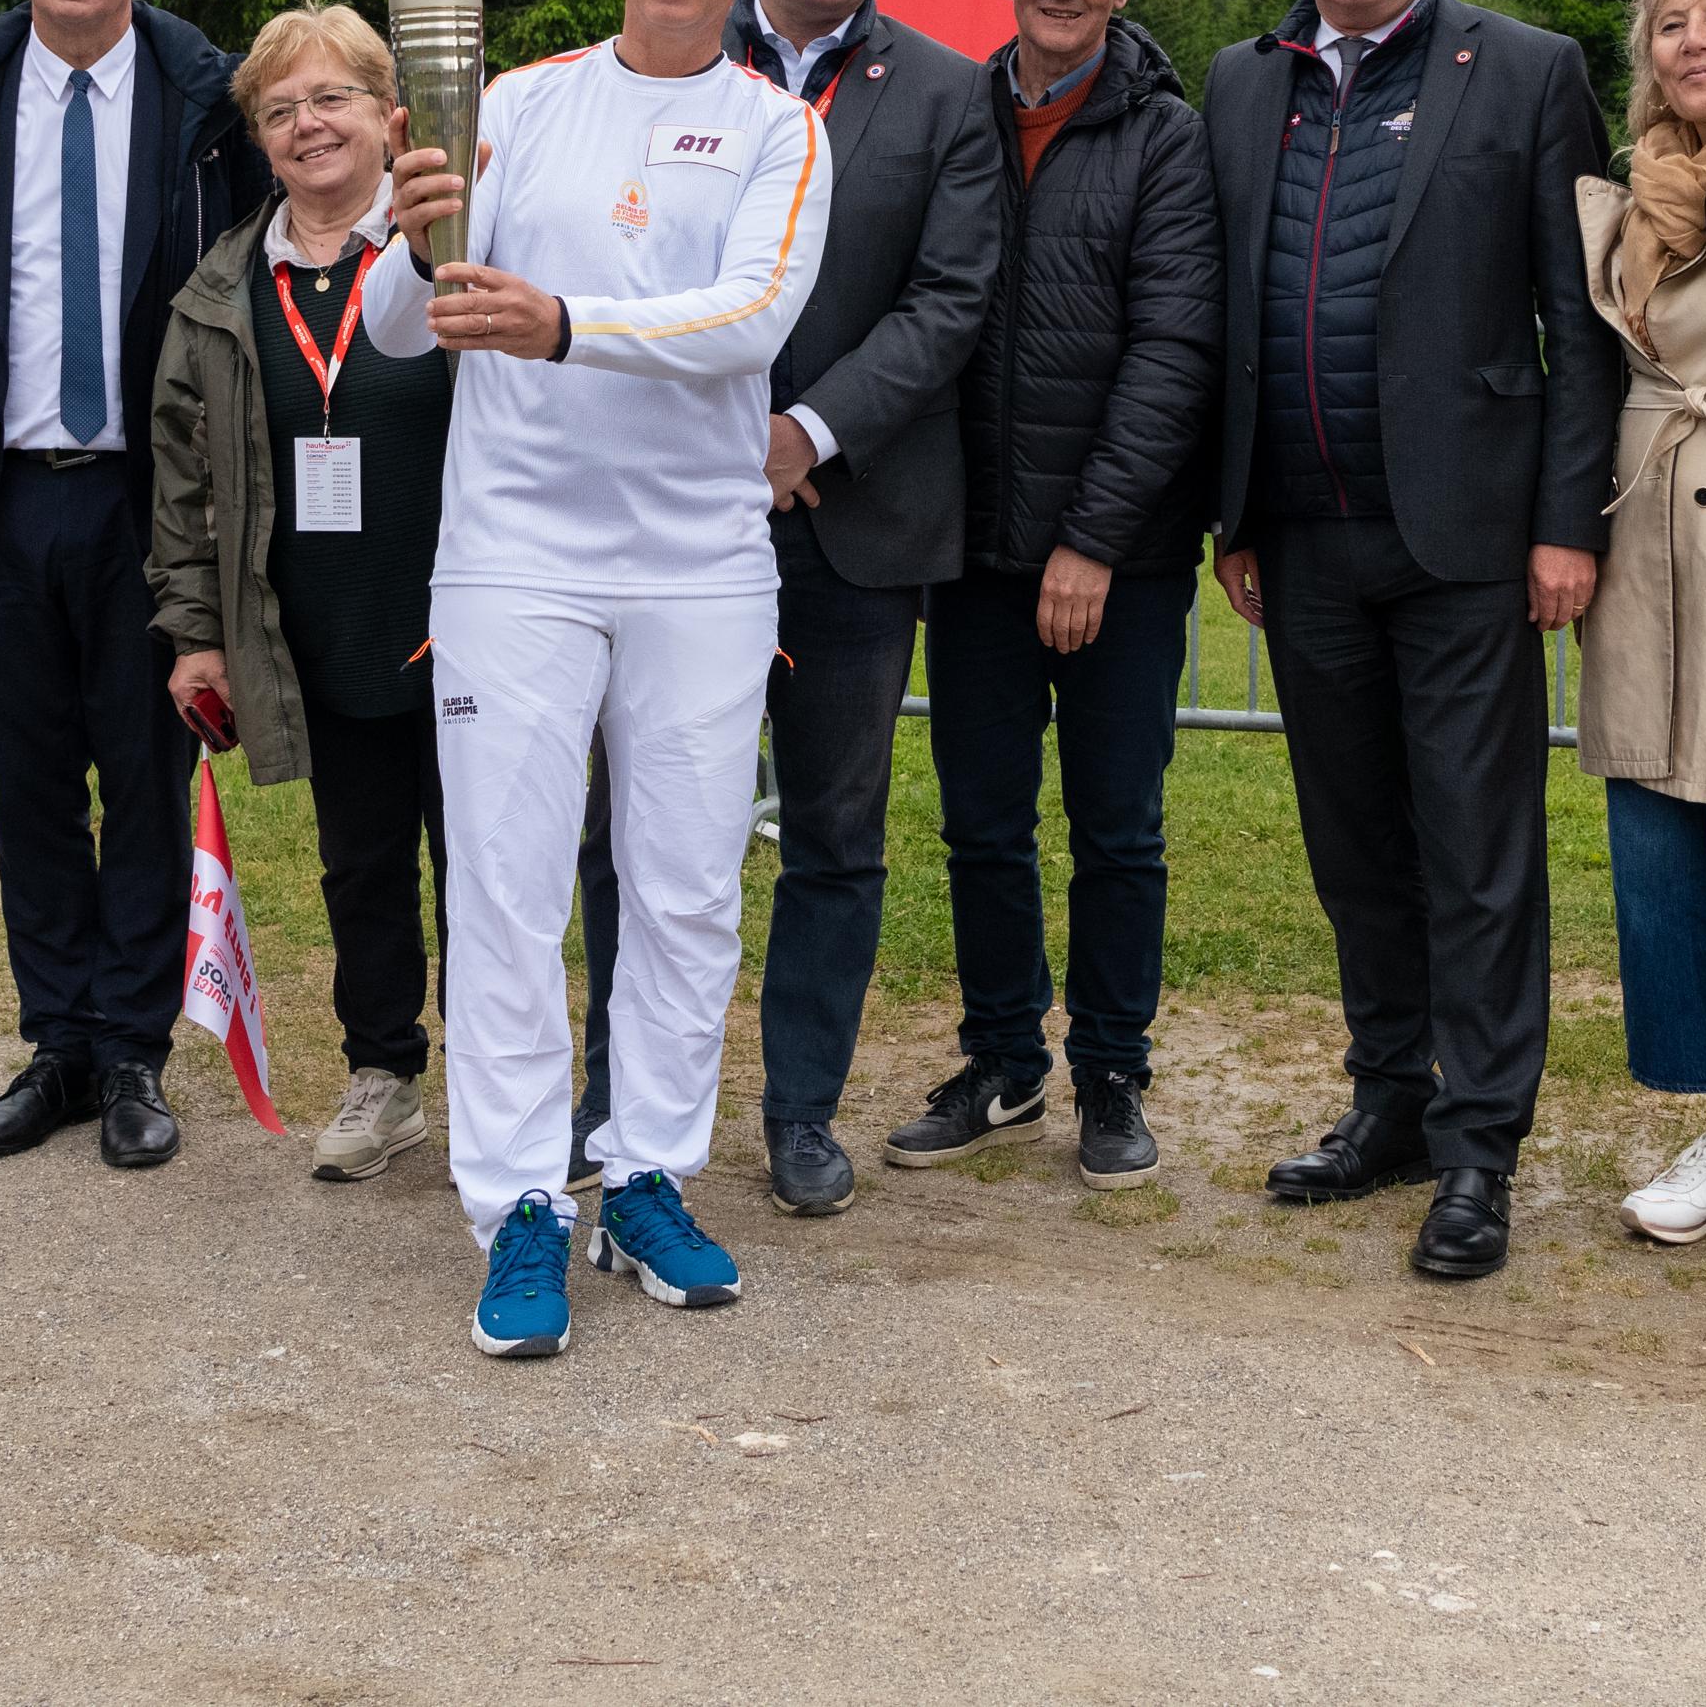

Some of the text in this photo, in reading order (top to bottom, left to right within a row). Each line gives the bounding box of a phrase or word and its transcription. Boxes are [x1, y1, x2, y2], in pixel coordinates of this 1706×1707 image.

[673, 134, 723, 154] A11
[463, 696, 473, 704] DE
[447, 705, 477, 715] FLAMME
